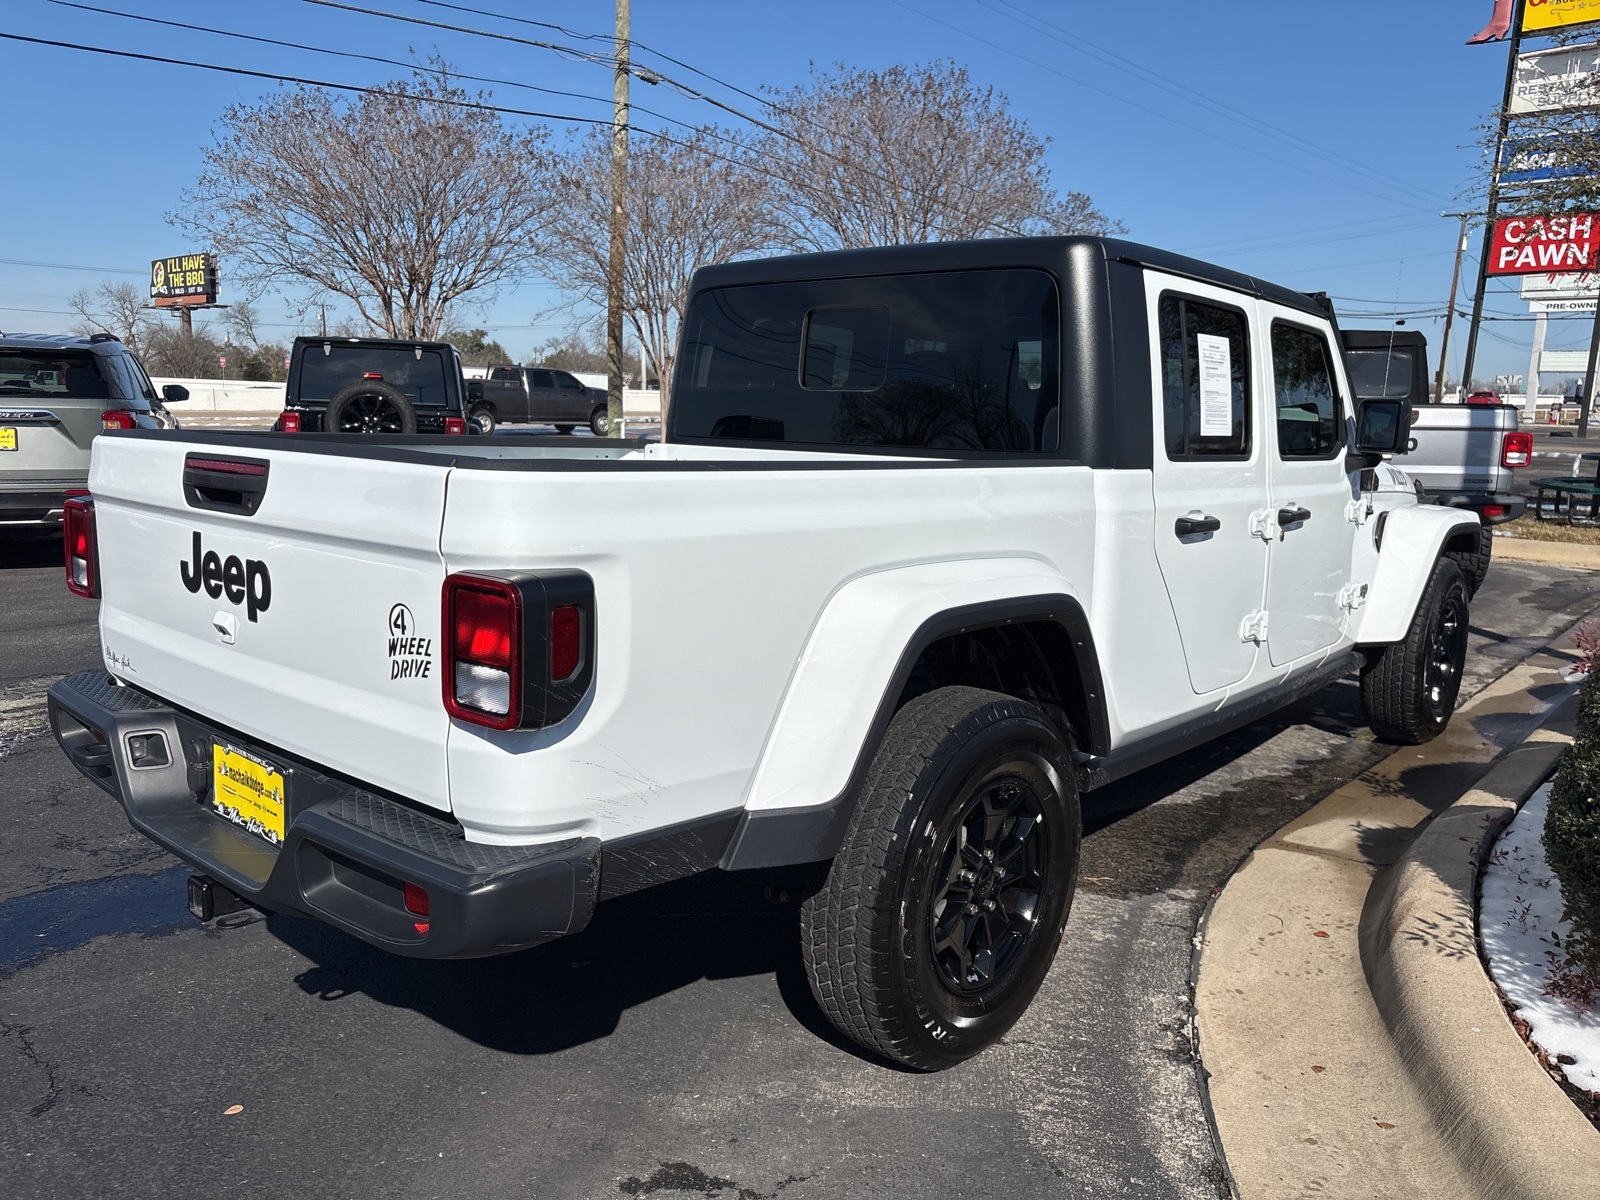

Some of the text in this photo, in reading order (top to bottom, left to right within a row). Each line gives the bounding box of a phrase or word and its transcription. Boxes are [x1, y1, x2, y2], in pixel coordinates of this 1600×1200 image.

[1504, 216, 1592, 243] CASH
[167, 255, 205, 272] I'LL HAVE
[1498, 242, 1590, 269] PAWN
[168, 271, 205, 287] THE BBQ
[180, 530, 272, 623] Jeep
[393, 608, 407, 635] 4
[388, 636, 432, 658] WHEEL
[391, 658, 432, 680] DRIVE
[228, 807, 246, 826] Mac
